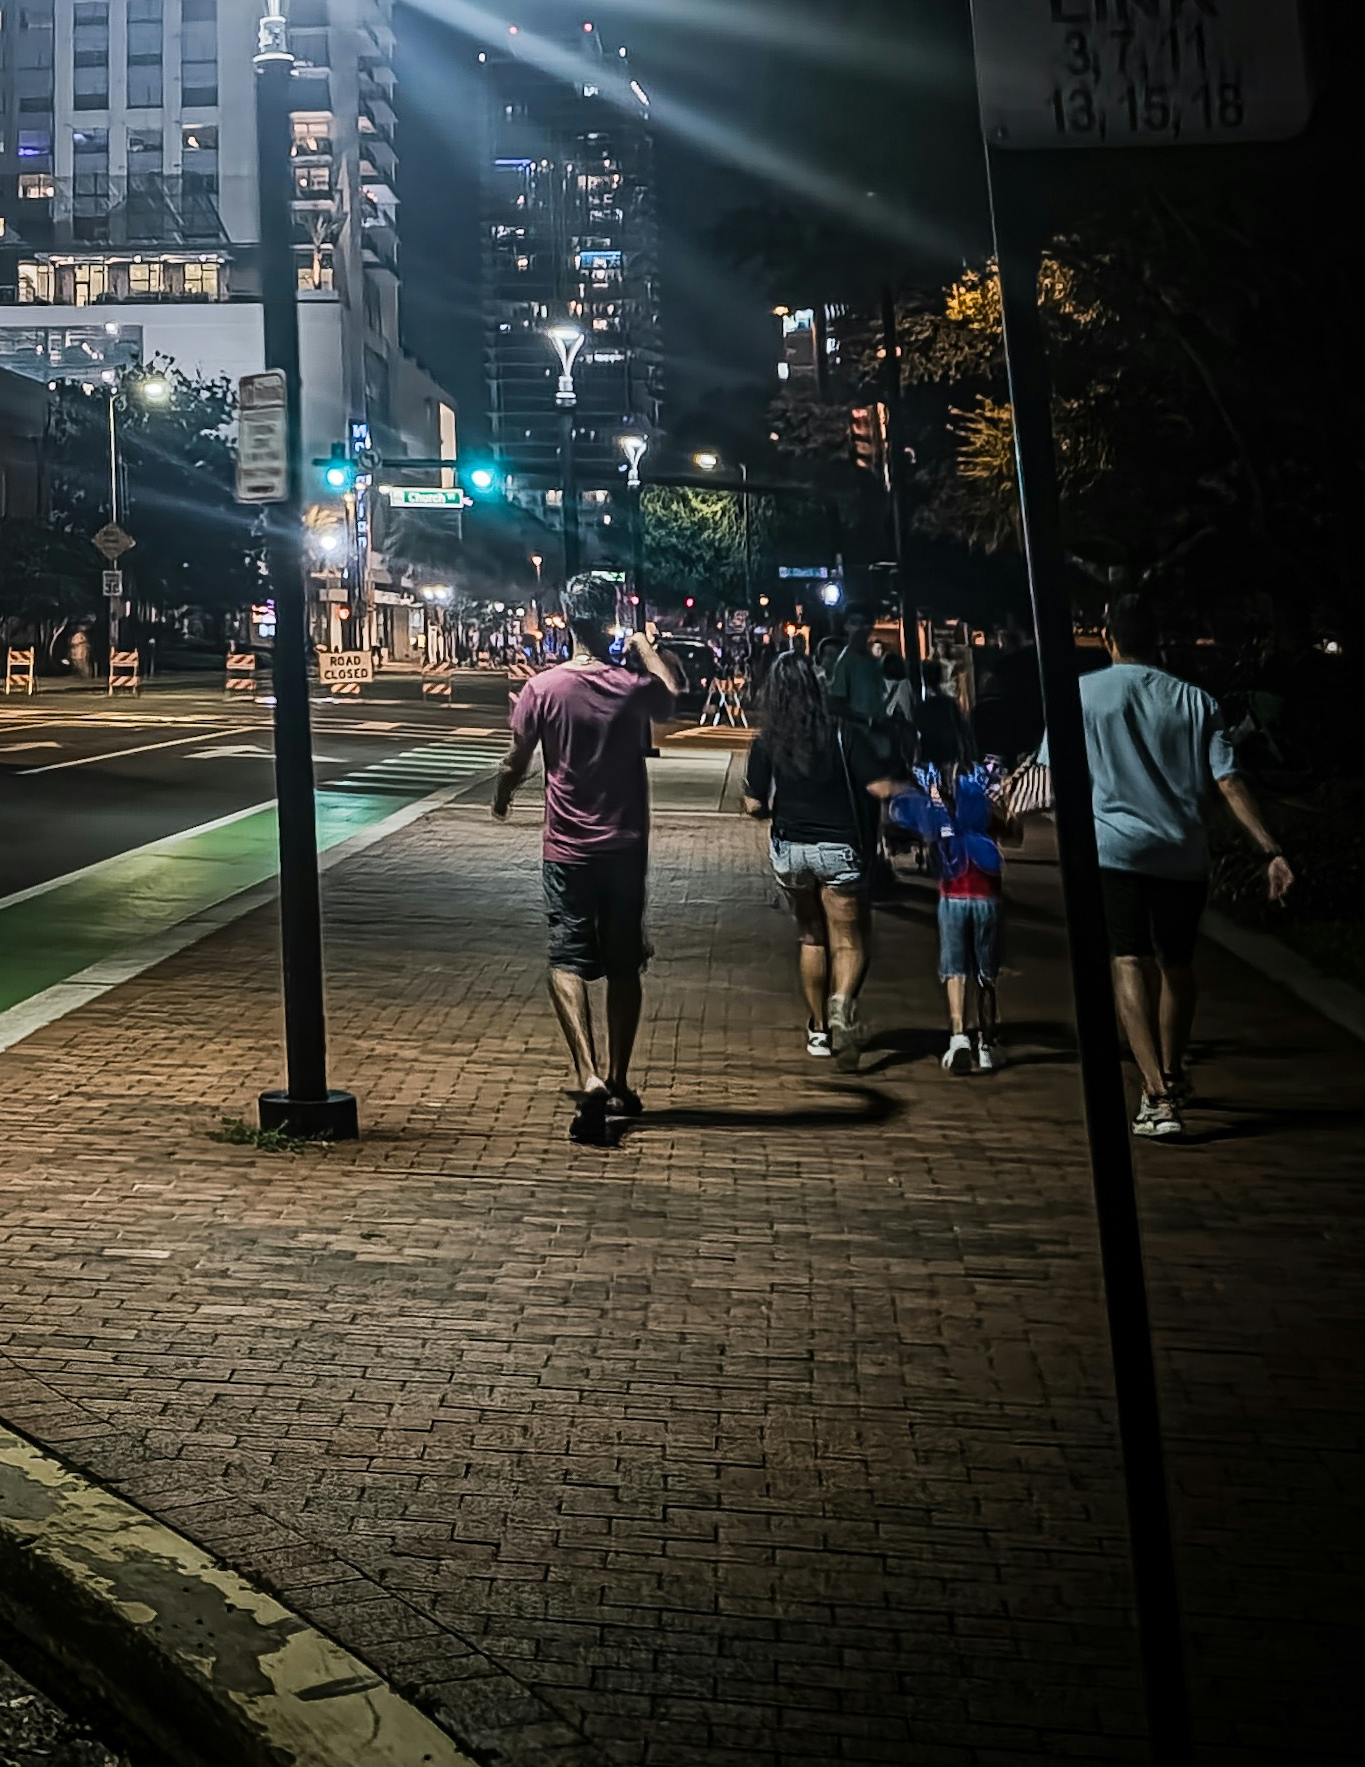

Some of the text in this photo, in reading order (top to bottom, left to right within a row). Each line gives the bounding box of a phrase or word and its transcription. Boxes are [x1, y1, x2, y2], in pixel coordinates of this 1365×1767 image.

[408, 492, 447, 504] Church
[330, 656, 361, 666] ROAD
[324, 668, 368, 680] CLOSED
